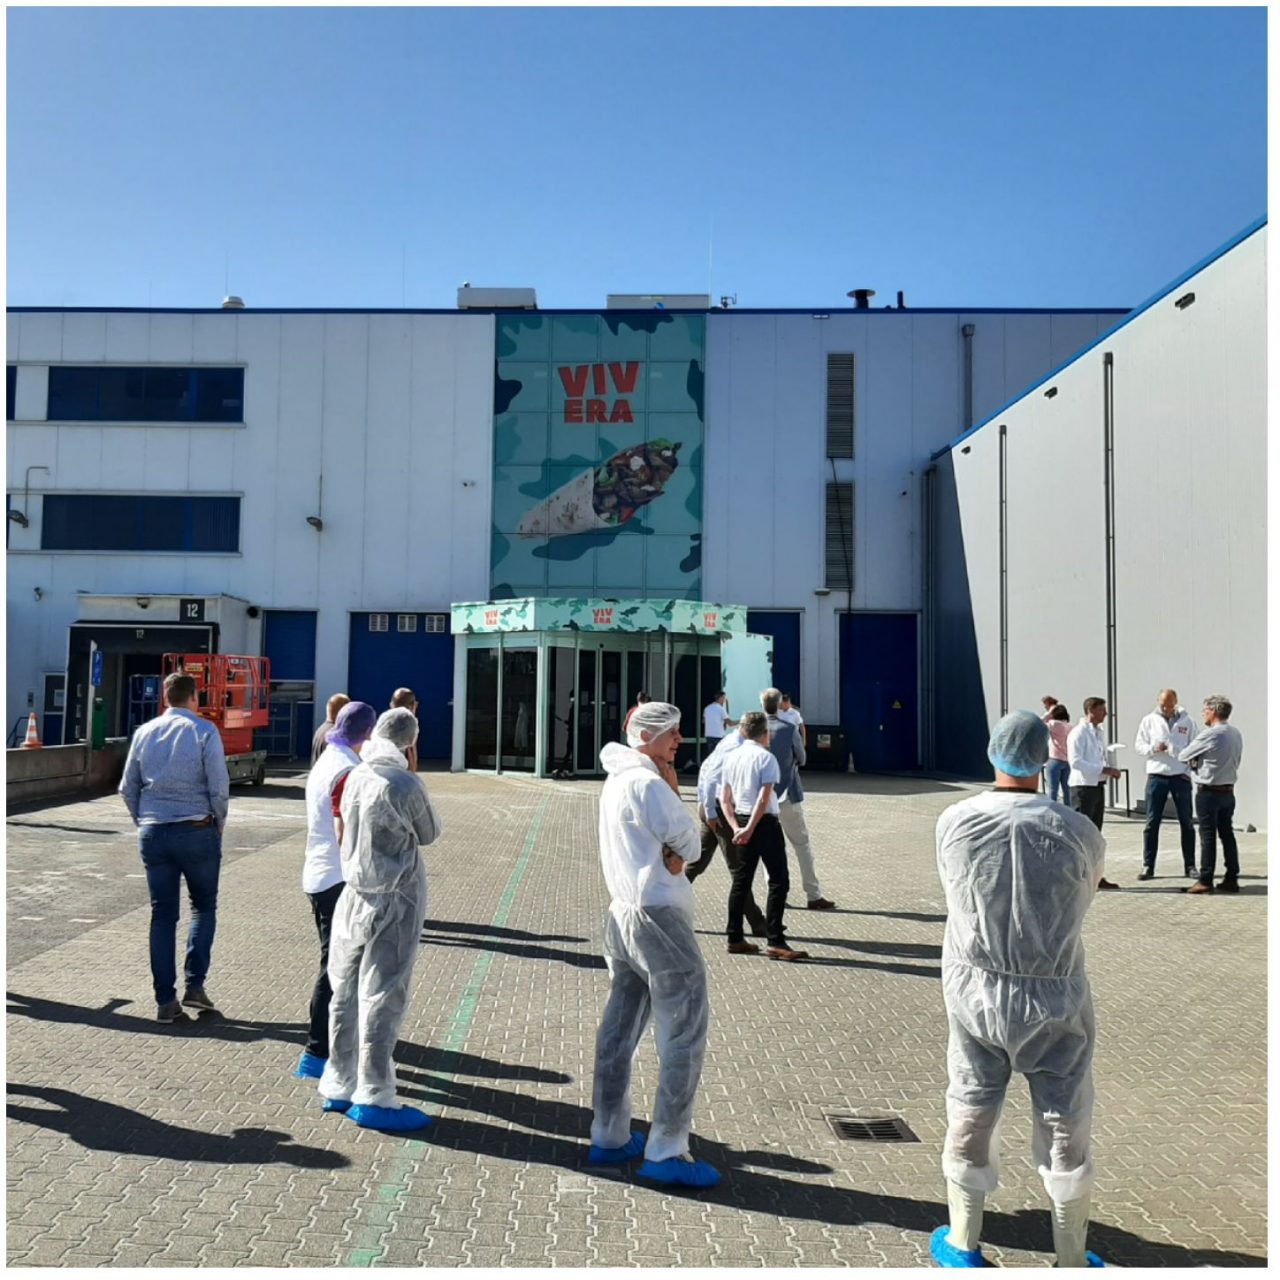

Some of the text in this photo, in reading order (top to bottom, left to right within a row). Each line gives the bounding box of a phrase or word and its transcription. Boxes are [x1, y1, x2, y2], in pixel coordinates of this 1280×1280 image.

[558, 361, 639, 397] VIV
[564, 399, 634, 423] ERA
[187, 603, 199, 618] 12
